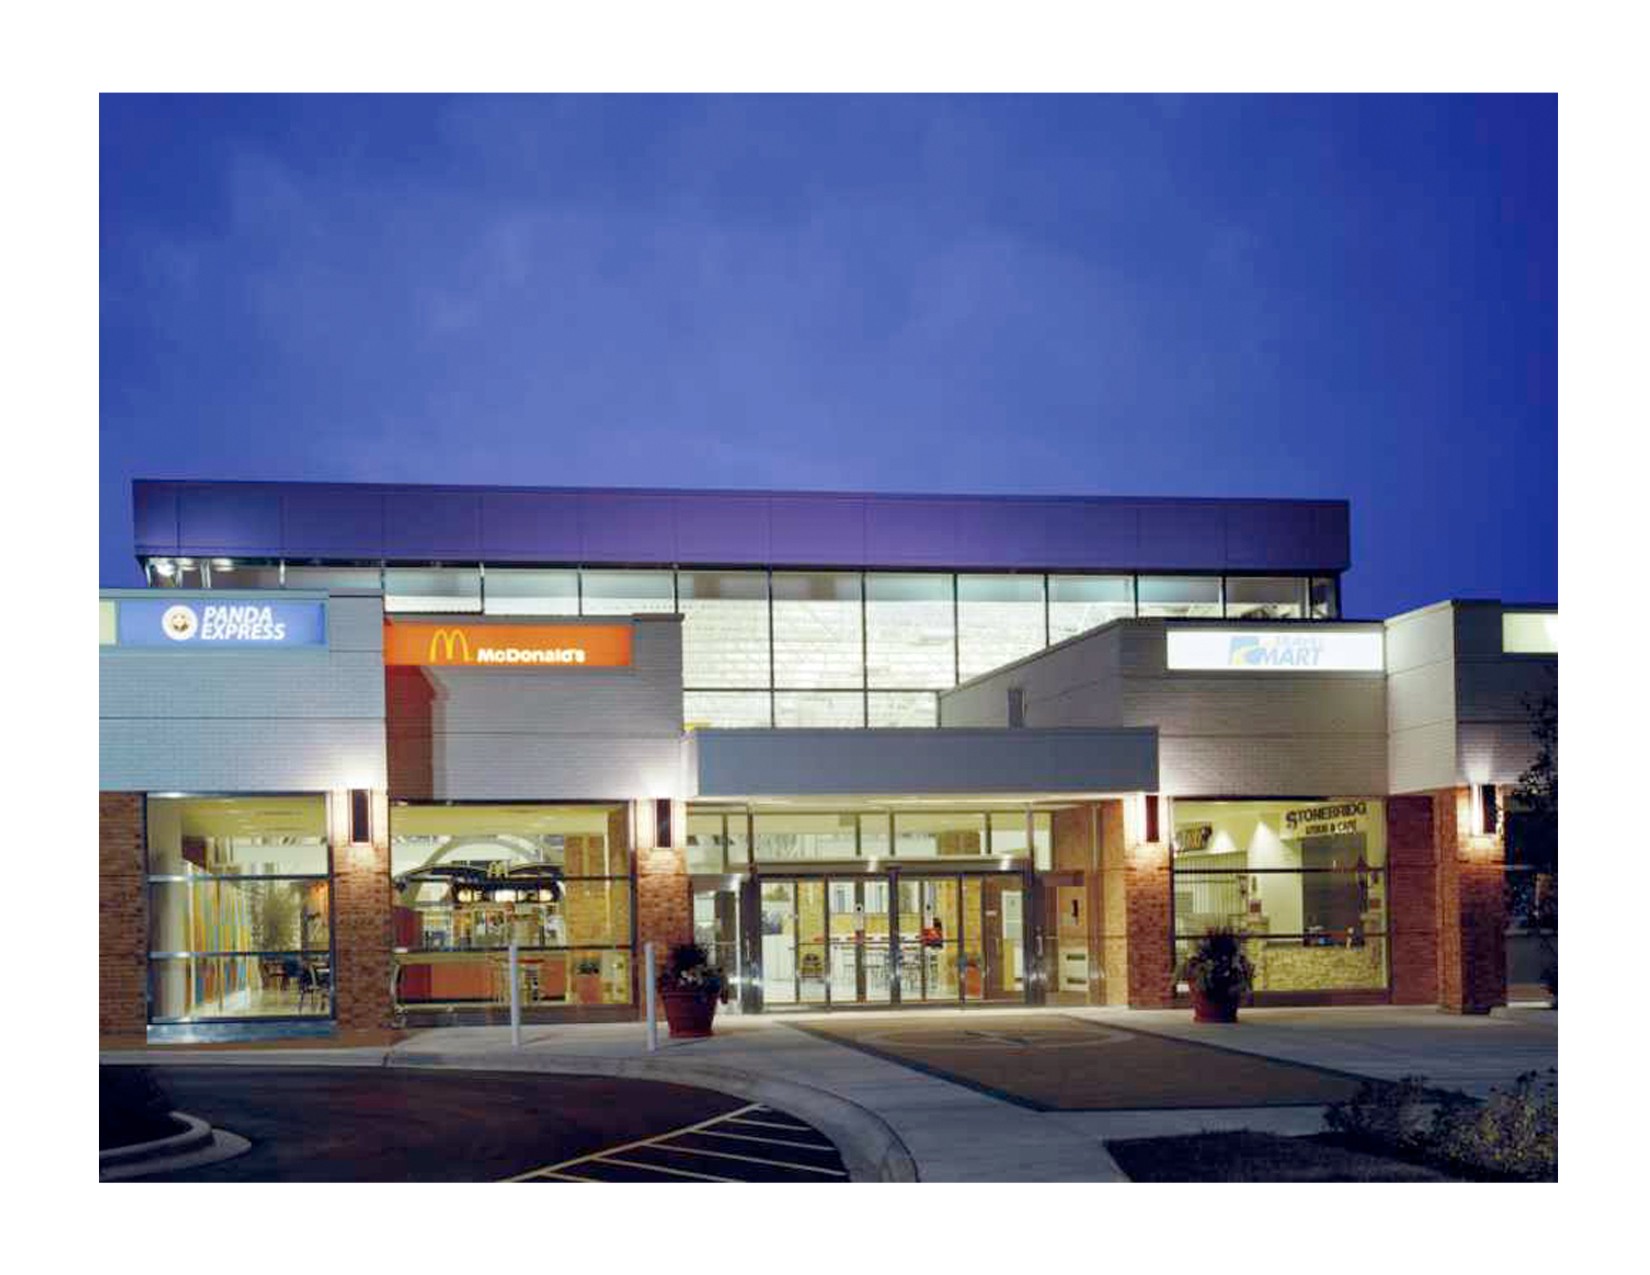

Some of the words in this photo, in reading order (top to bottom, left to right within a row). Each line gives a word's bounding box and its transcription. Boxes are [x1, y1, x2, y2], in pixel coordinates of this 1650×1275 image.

[202, 606, 272, 624] PANDA
[201, 623, 286, 640] EXPRESS
[476, 648, 586, 663] McDonald's
